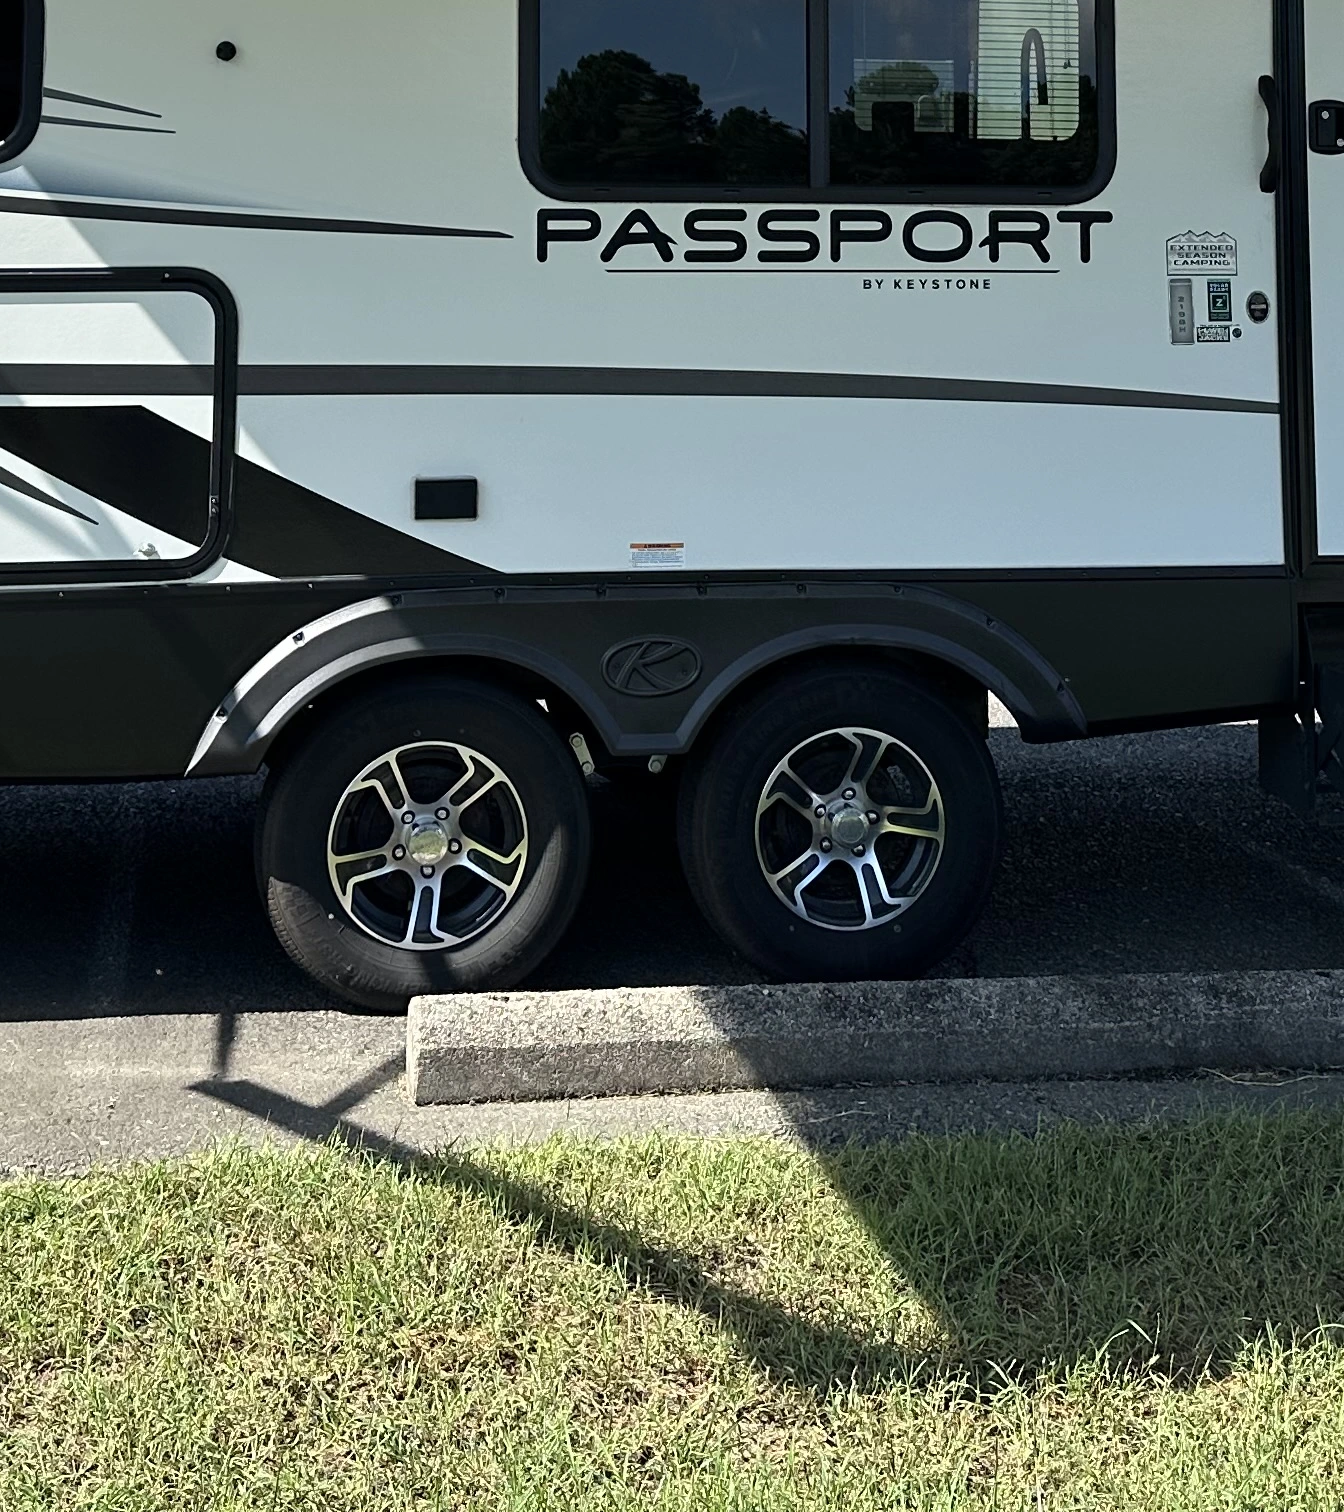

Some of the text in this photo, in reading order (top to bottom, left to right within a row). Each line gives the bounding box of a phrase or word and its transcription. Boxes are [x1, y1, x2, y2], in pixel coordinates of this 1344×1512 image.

[537, 208, 1113, 264] PASSPORT
[862, 278, 993, 290] BY KEYSTONE
